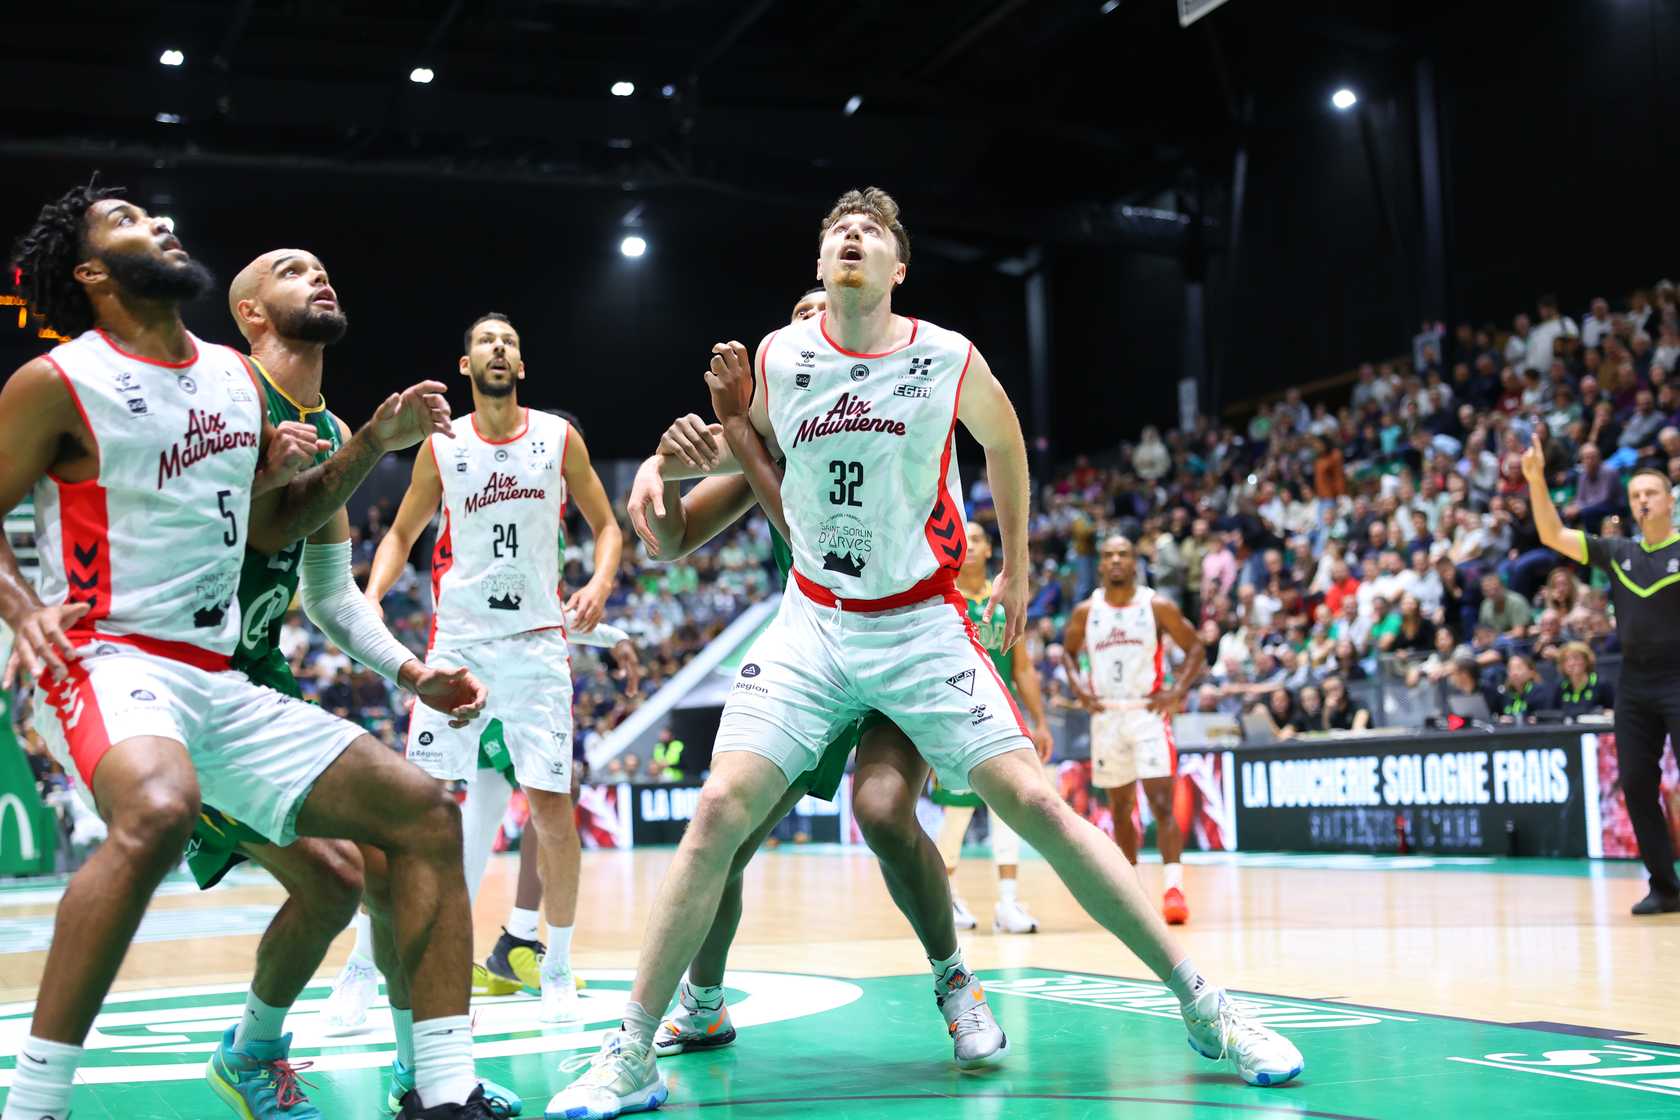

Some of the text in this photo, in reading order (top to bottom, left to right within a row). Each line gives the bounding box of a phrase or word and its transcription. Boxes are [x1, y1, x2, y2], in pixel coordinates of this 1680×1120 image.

[826, 393, 872, 421] Aix
[184, 408, 226, 447] Aix
[793, 413, 906, 448] Maurienne
[158, 431, 257, 490] Maurienne
[484, 472, 518, 497] Aix
[829, 460, 864, 507] 32
[217, 490, 237, 547] 5
[464, 487, 545, 518] Maurienne
[493, 523, 519, 559] 24
[843, 526, 873, 538] SORLIN
[1113, 660, 1123, 682] 3
[1242, 748, 1569, 808] LA BOUCHERIE SOLOGNE FRAIS
